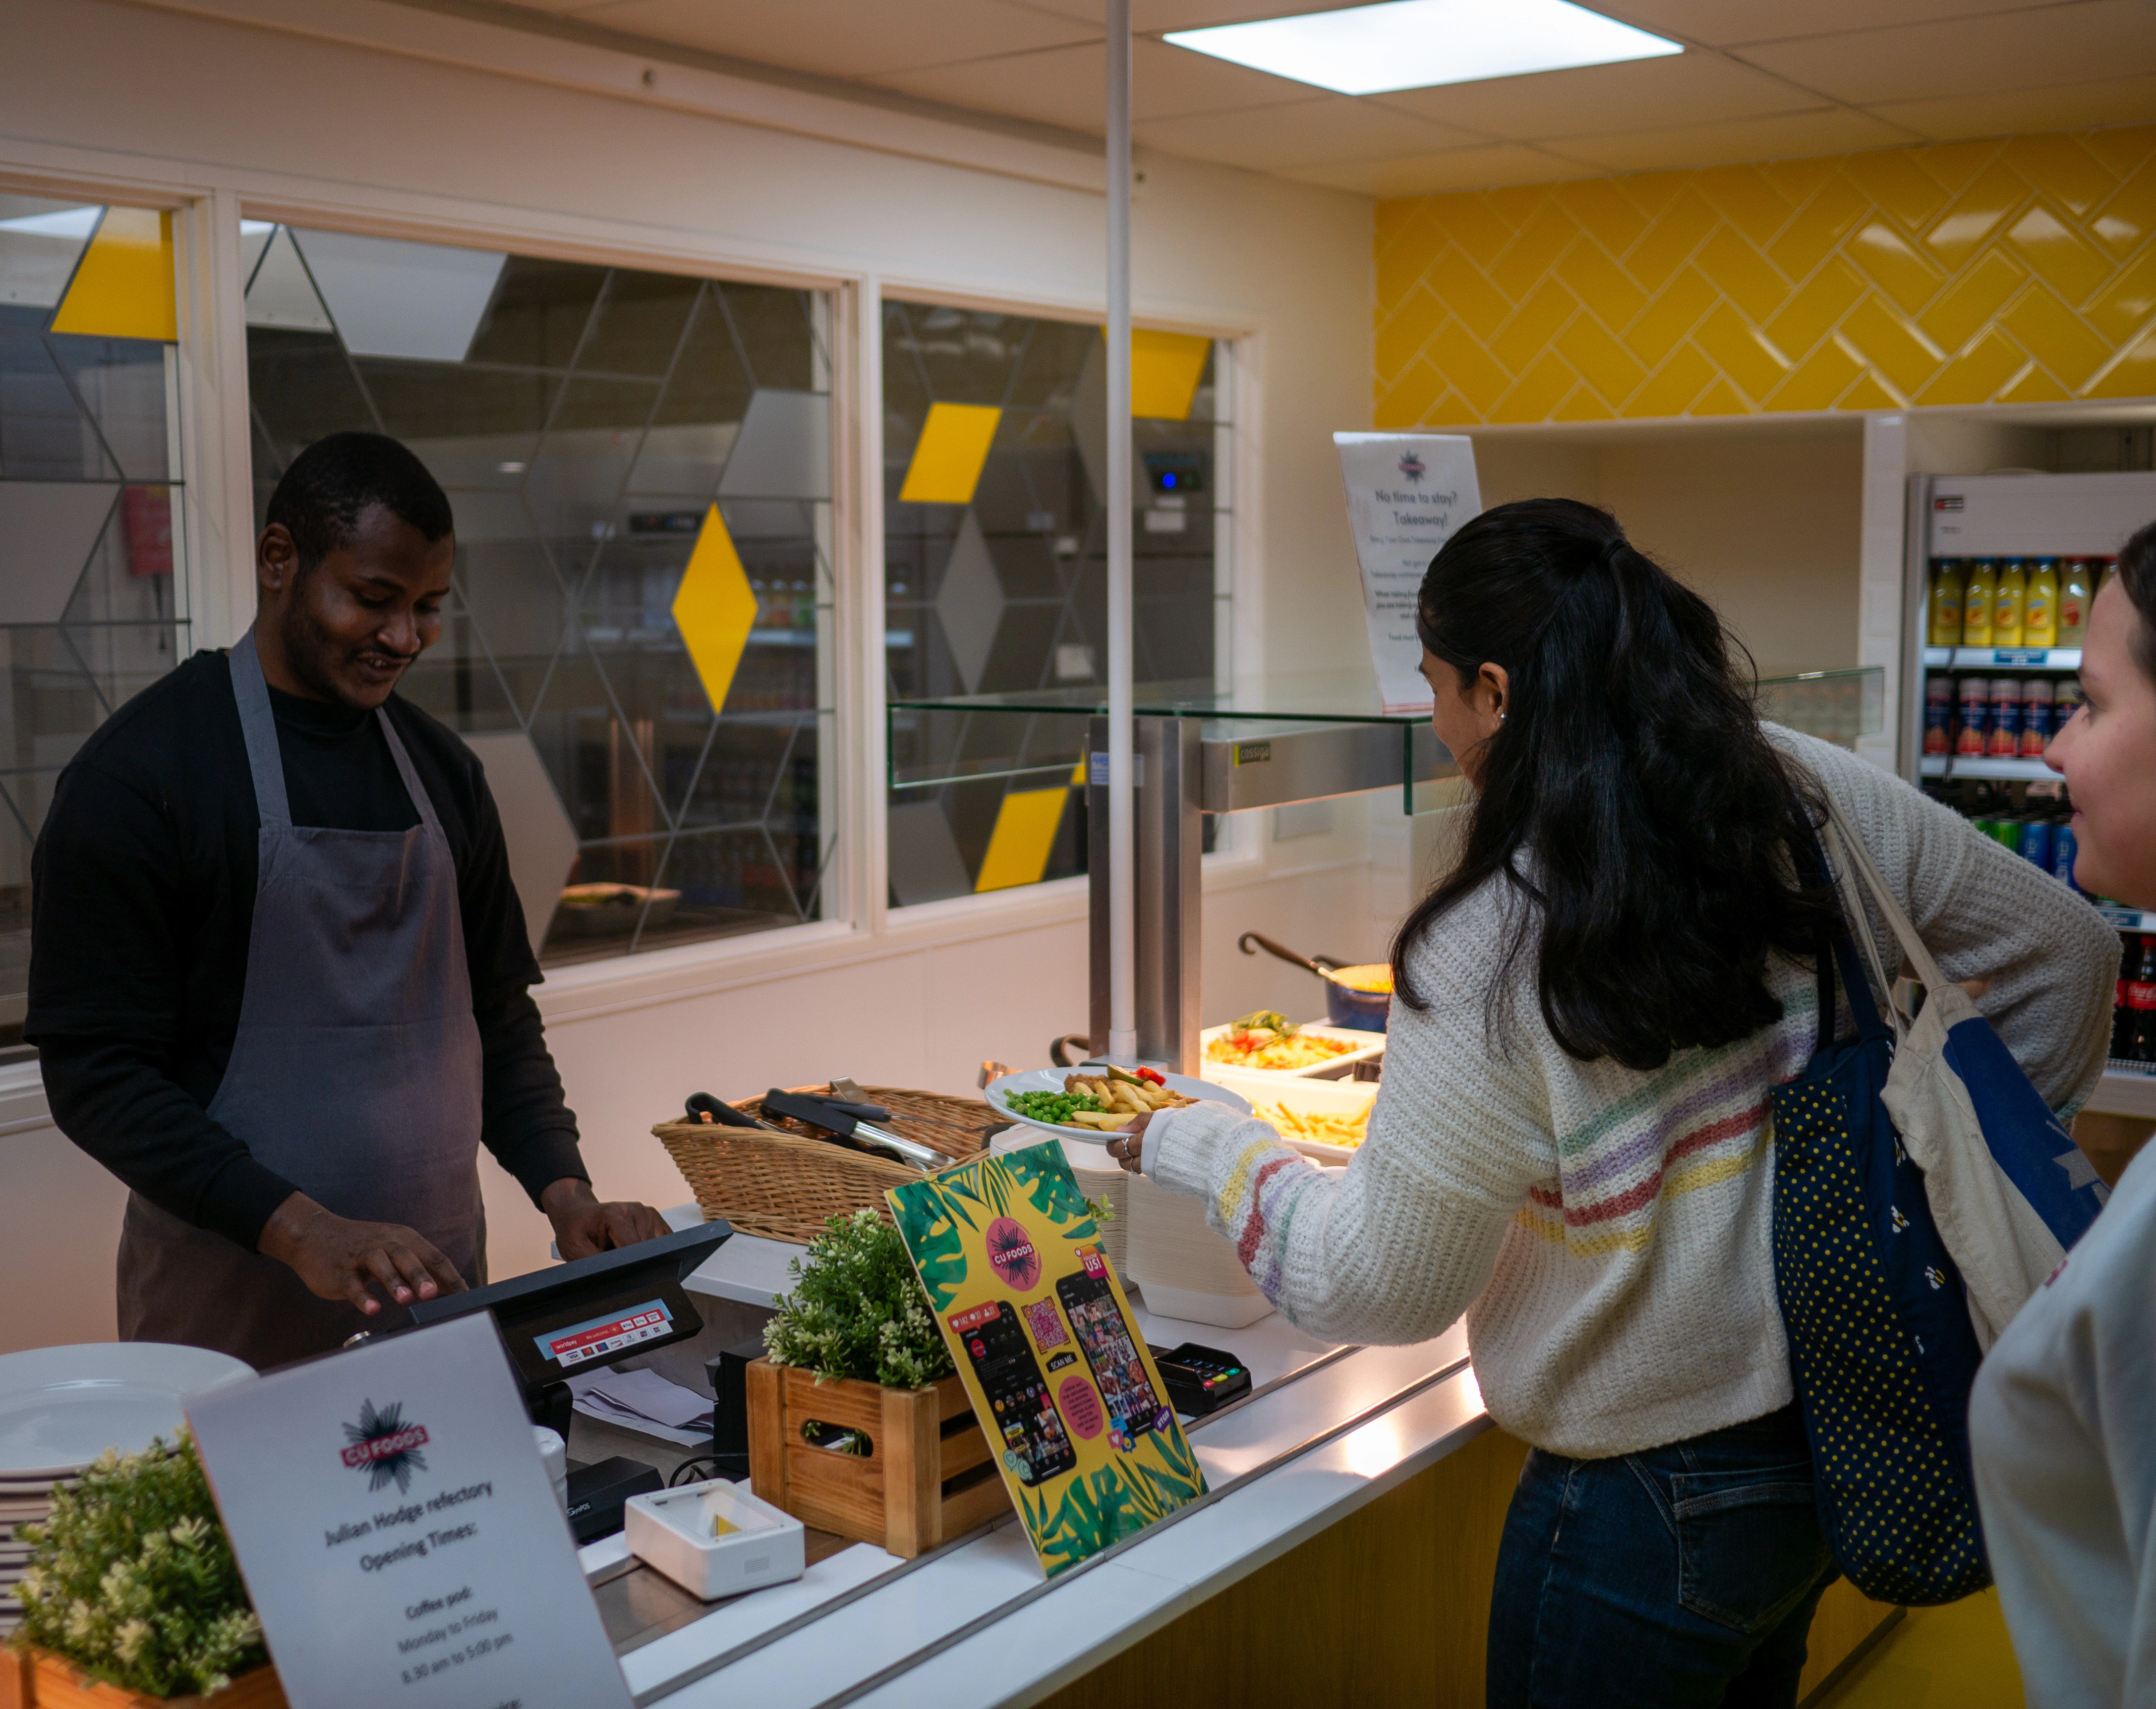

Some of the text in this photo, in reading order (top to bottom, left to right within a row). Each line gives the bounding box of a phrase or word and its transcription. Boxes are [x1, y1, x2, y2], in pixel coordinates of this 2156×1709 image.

[1375, 489, 1457, 507] No time to stay?
[1393, 511, 1448, 529] Takeaway!
[994, 1244, 1032, 1264] CU FOODS
[1083, 1253, 1097, 1261] FOLLOW
[1085, 1257, 1102, 1271] US!
[958, 1316, 968, 1325] 142
[975, 1310, 981, 1319] 37
[556, 1339, 577, 1349] worldpay
[1051, 1355, 1073, 1369] SCAN ME
[1157, 1410, 1169, 1428] #TGIF
[345, 1429, 425, 1463] CU FOODS
[325, 1481, 492, 1547] Julian Hodge refectory
[360, 1522, 478, 1572] Opening Times:
[405, 1586, 473, 1620] Coffee pod:
[398, 1608, 498, 1653] Monday to Friday
[431, 1658, 450, 1672] am
[451, 1652, 465, 1663] to
[494, 1633, 513, 1651] pm
